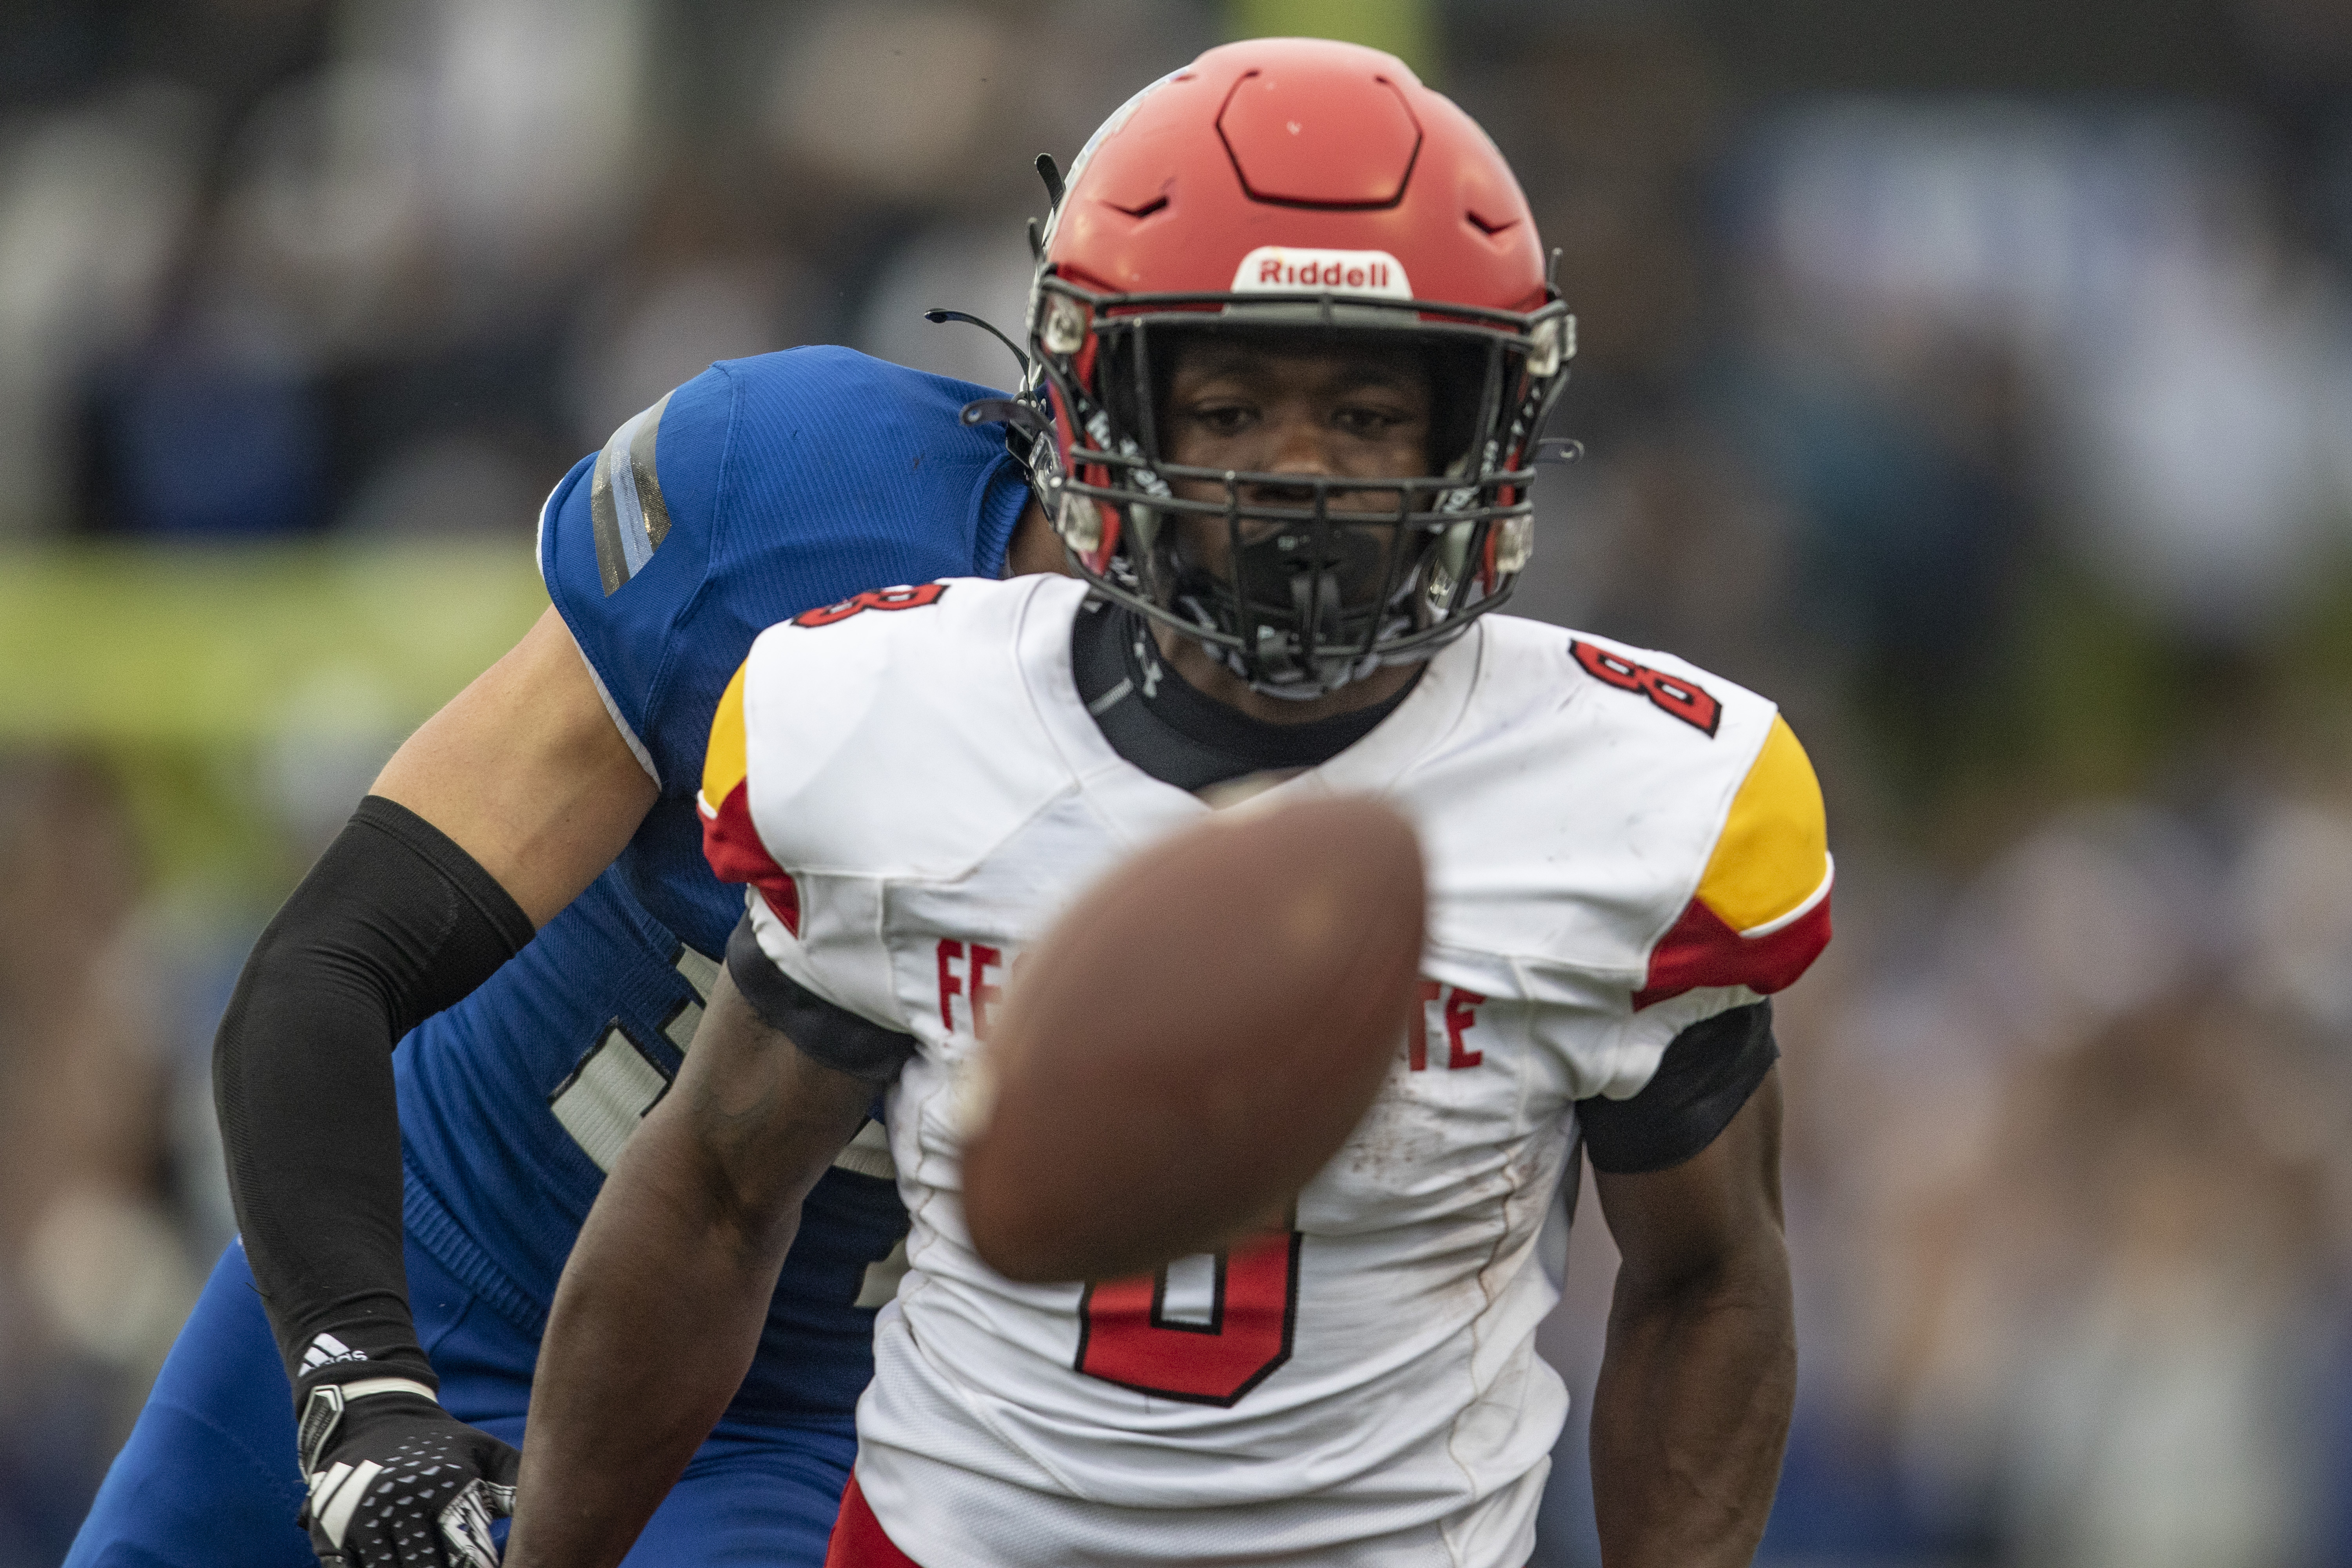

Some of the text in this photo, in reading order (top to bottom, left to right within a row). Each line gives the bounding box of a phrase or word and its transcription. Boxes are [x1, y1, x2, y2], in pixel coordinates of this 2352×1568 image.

[1259, 259, 1389, 288] Riddell
[789, 582, 950, 629] 8
[1567, 637, 1723, 740] 8
